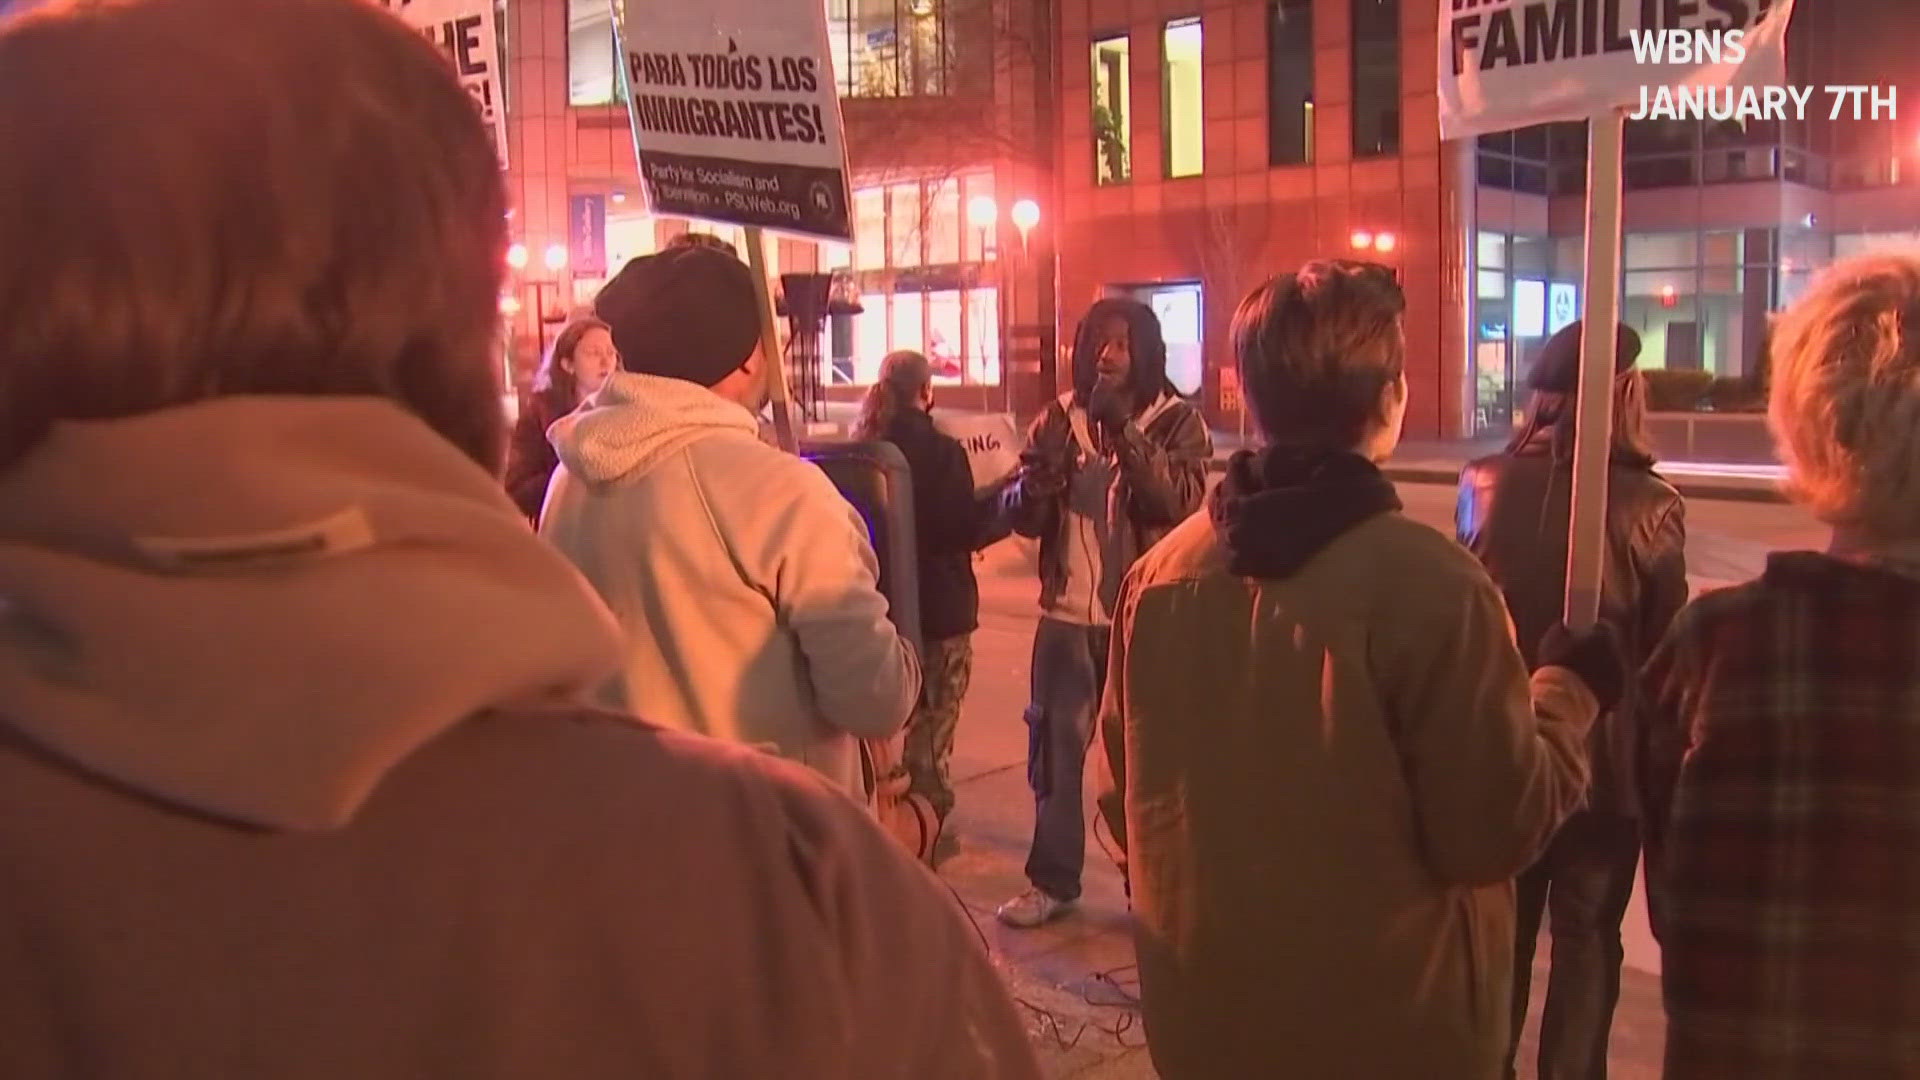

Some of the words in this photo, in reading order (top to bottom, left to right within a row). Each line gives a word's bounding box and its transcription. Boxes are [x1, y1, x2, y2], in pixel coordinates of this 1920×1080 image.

[420, 14, 488, 76] HE
[629, 52, 686, 86] PARA
[688, 53, 763, 92] TODOS
[767, 56, 818, 93] LOS
[635, 94, 826, 145] INMIGRANTES!
[650, 162, 680, 186] Party
[696, 166, 754, 190] Socialism
[754, 175, 780, 193] and
[957, 433, 1001, 454] ING
